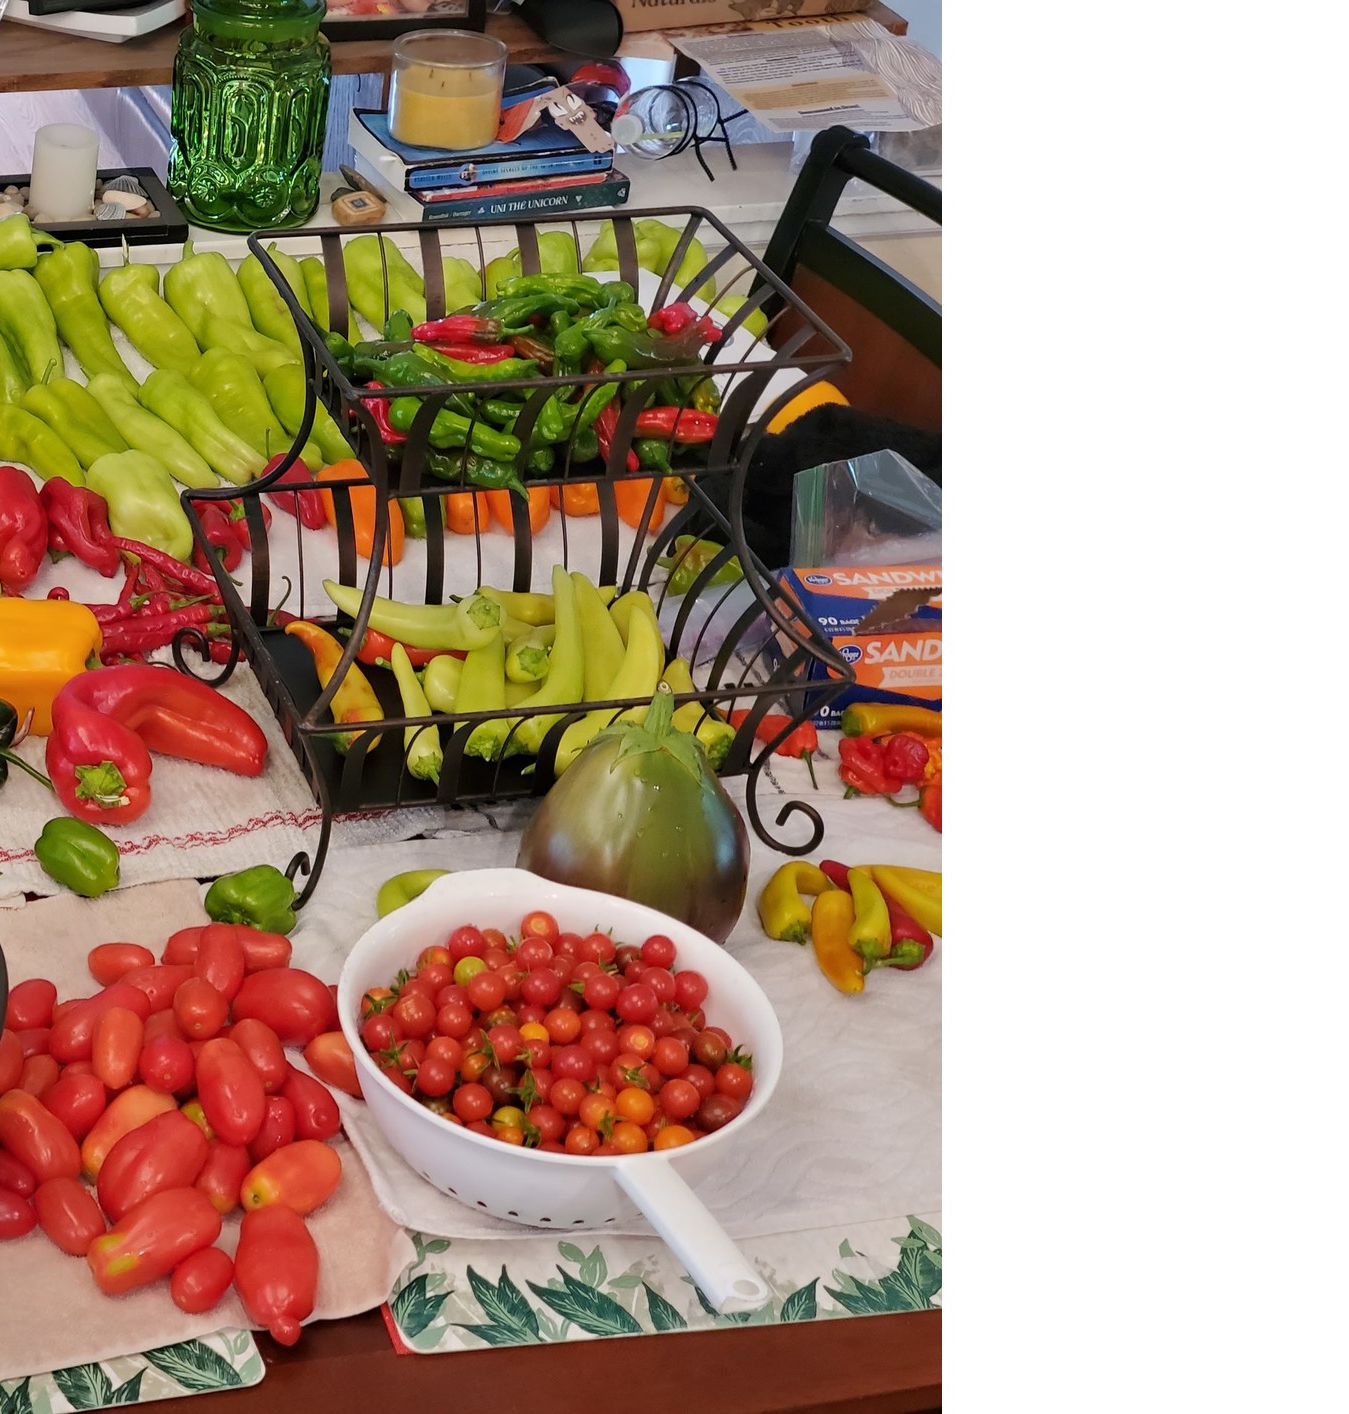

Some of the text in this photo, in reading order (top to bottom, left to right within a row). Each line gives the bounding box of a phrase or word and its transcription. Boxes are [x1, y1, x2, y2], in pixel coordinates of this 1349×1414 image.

[766, 16, 850, 28] Tooth
[490, 195, 568, 214] UNI THE UNICORN
[818, 617, 838, 626] 90
[889, 668, 937, 679] DOUBLE
